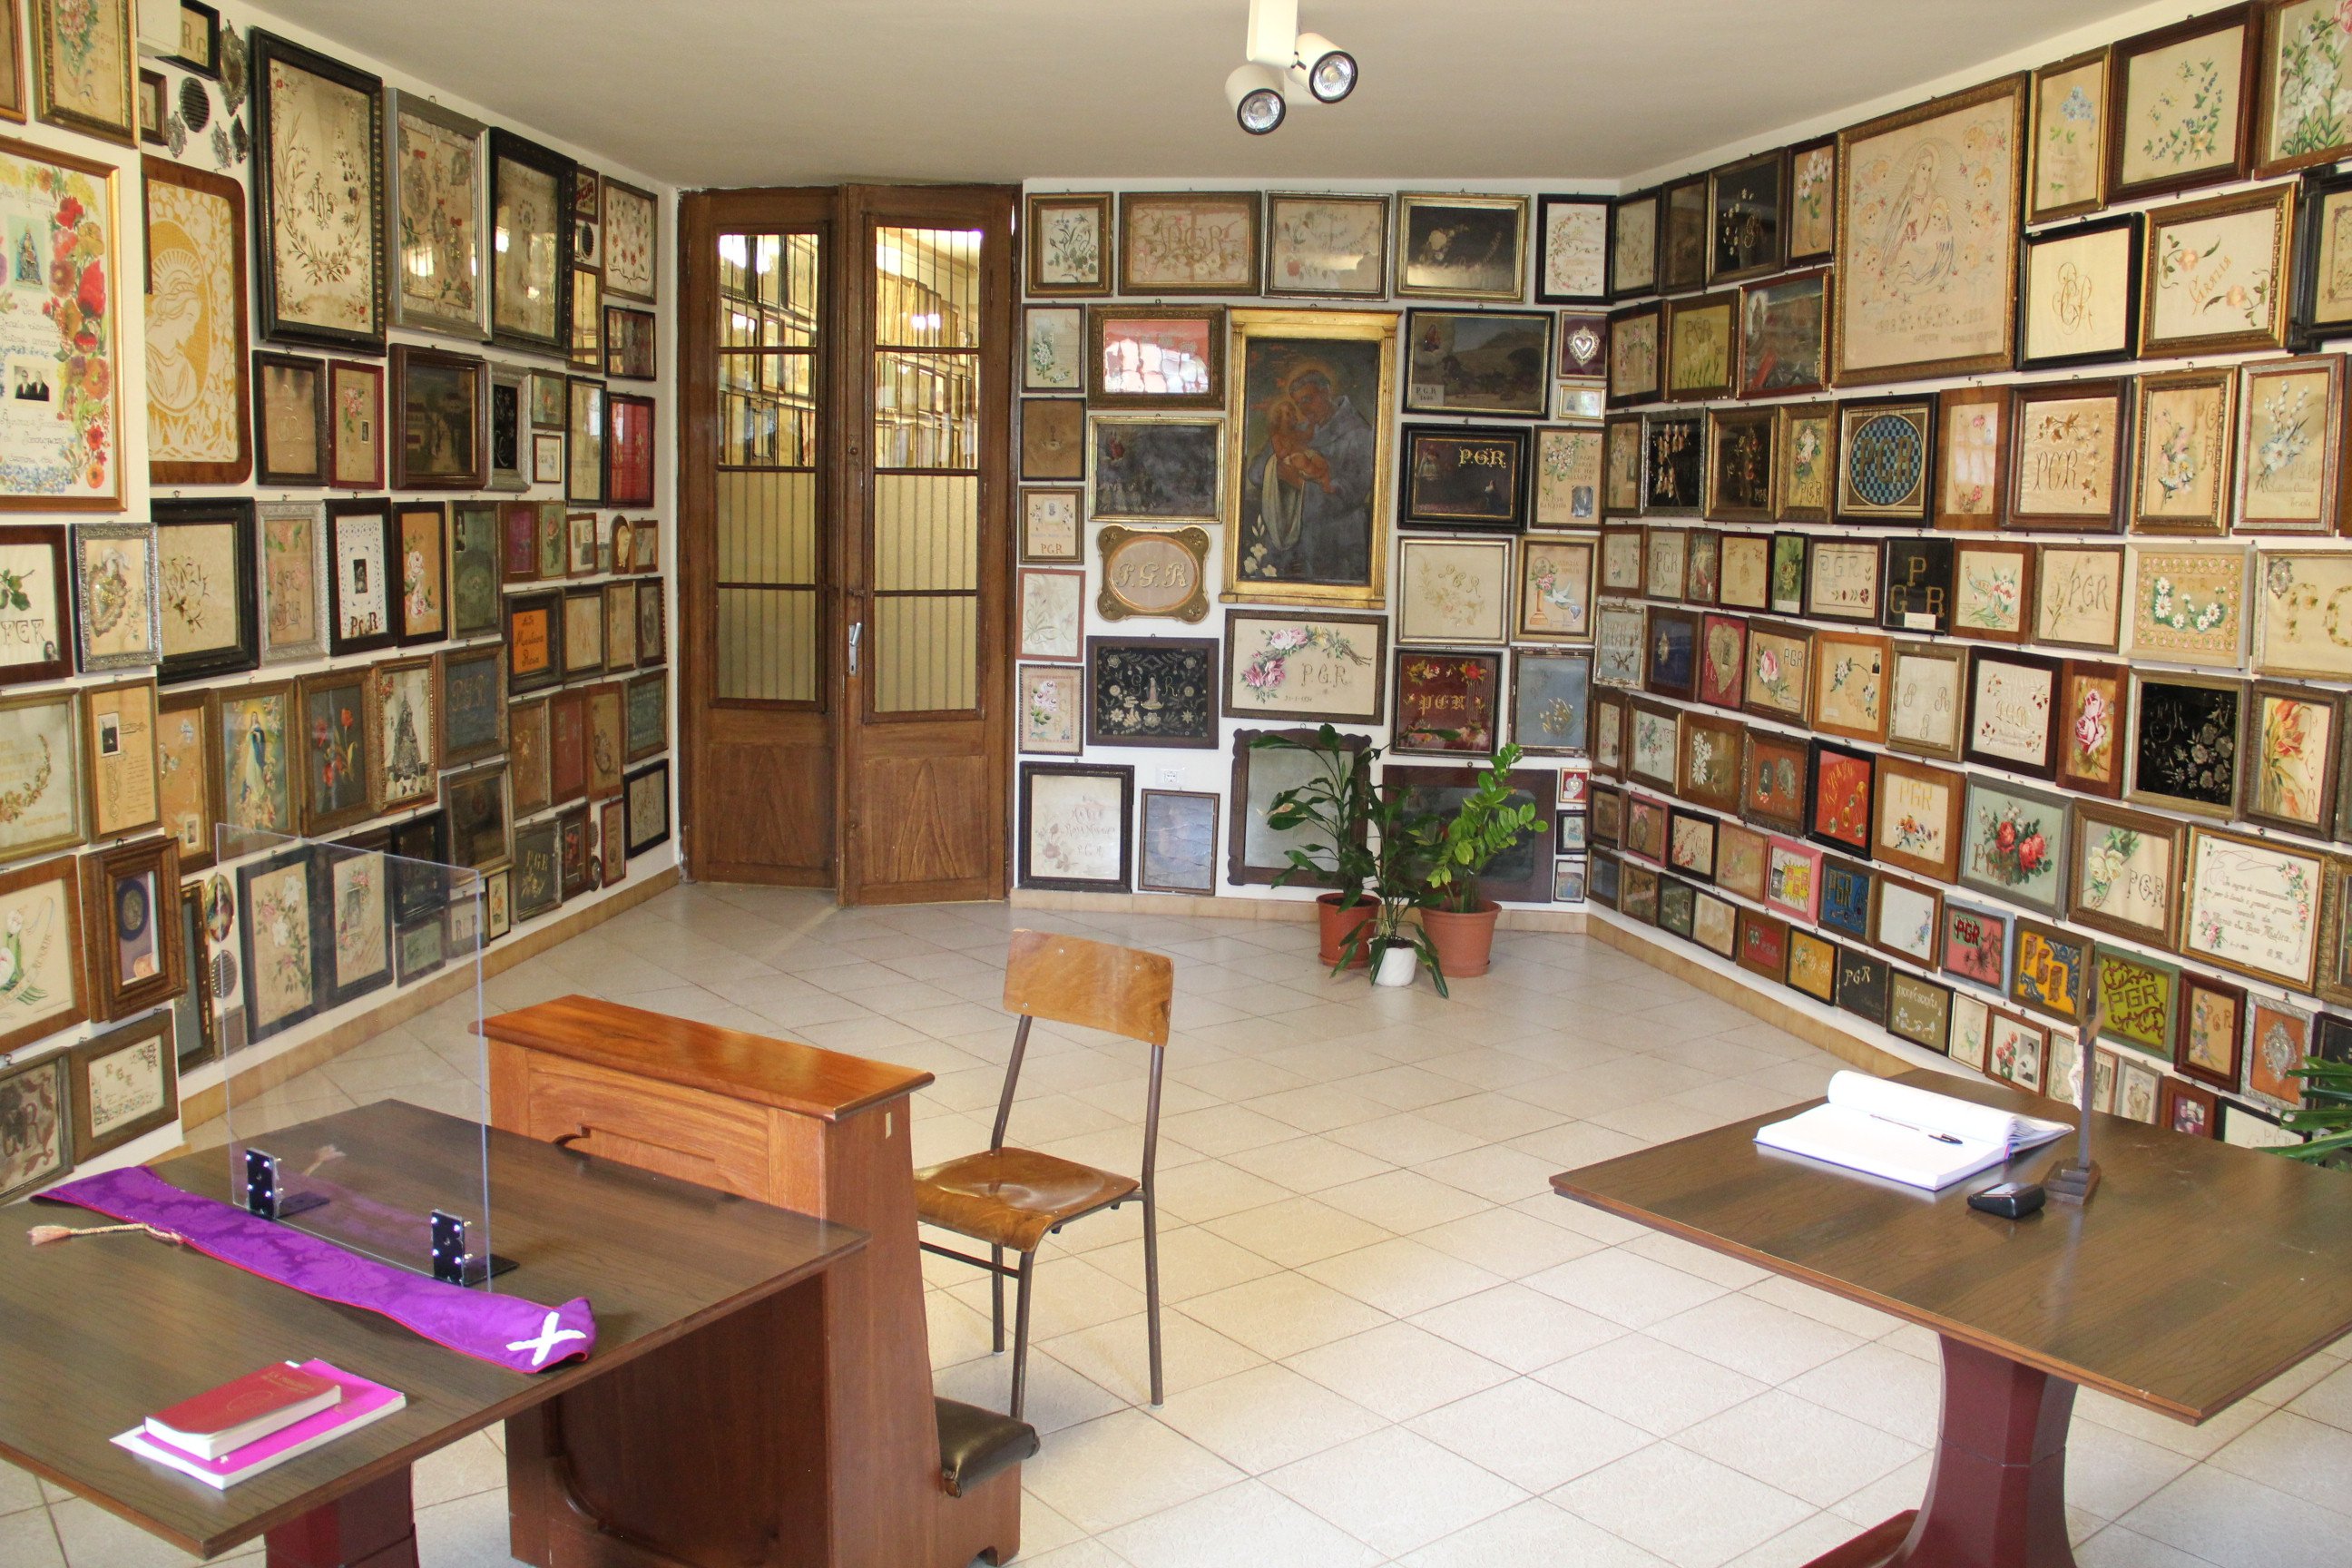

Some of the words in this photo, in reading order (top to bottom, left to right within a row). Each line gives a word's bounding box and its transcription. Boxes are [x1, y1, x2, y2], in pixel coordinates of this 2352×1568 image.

[1161, 223, 1224, 255] PGR
[1859, 435, 1913, 485] PGR
[2033, 449, 2079, 492] PGR
[1041, 543, 1063, 555] PGR
[1907, 556, 1927, 587] P
[1890, 584, 1908, 614] G
[1926, 585, 1945, 618] R
[2068, 573, 2110, 612] PGR
[1783, 648, 1804, 668] PGR
[2126, 867, 2165, 909] PGR
[1954, 914, 1980, 946] PGR
[1843, 965, 1871, 987] PGR
[2024, 936, 2063, 1003] PGR
[2107, 984, 2161, 1014] PGR
